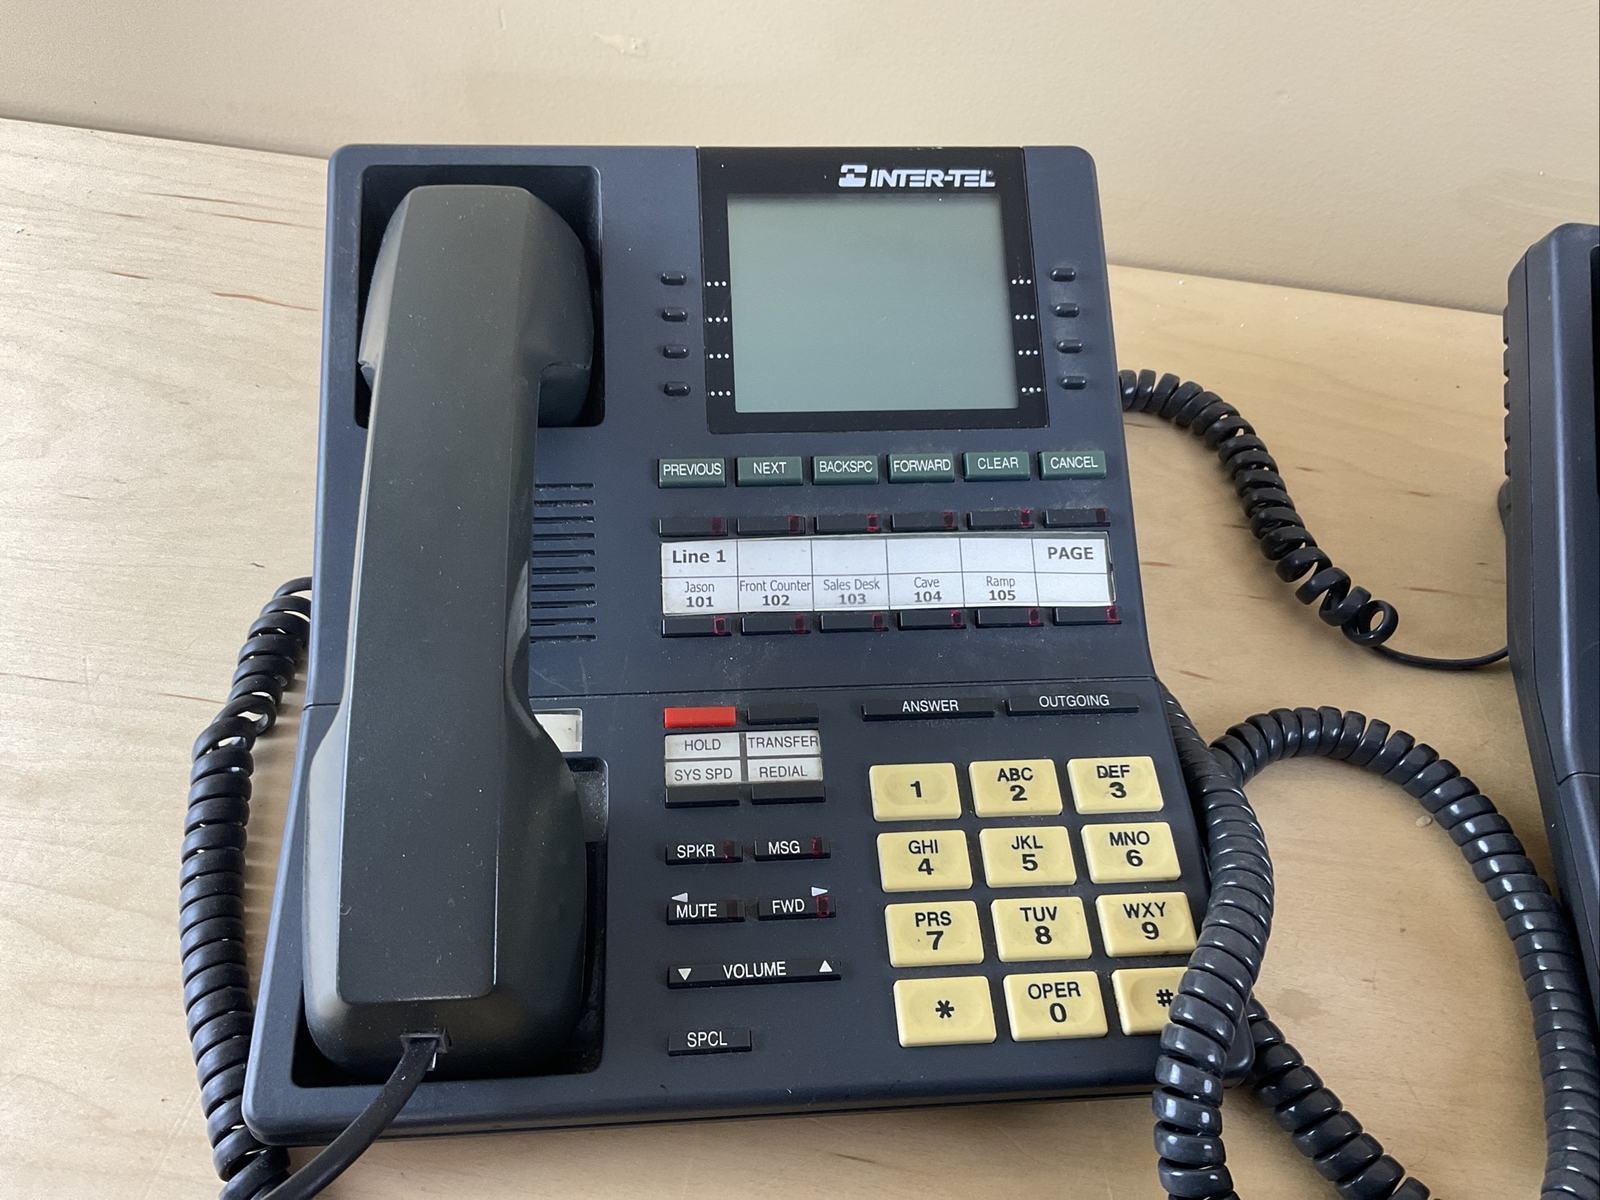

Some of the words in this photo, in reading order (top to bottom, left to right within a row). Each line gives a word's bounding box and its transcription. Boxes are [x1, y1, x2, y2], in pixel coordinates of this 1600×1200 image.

[663, 462, 722, 476] PREVIOUS
[753, 461, 787, 474] NEXT
[819, 460, 873, 473] BACKSPC
[893, 458, 951, 473] FORWARD
[977, 456, 1019, 470] CLEAR
[1050, 456, 1099, 470] CANCEL
[672, 549, 710, 564] Line
[716, 549, 727, 563] 1
[1047, 546, 1094, 560] PAGE
[684, 581, 715, 594] Jason
[739, 580, 768, 593] Front
[770, 579, 812, 592] Counter
[823, 577, 851, 591] Sales
[853, 577, 881, 591] Desk
[913, 576, 940, 589] Cave
[986, 575, 1016, 589] Ramp
[686, 596, 714, 608] 101
[762, 594, 790, 606] 102
[839, 593, 866, 605] 103
[914, 590, 942, 603] 104
[988, 589, 1016, 601] 105
[902, 699, 959, 713] ANSWER
[1039, 694, 1110, 708] OUTGOING
[684, 738, 722, 751] HOLD
[747, 735, 819, 749] TRANSFER
[674, 768, 702, 782] SYS
[705, 767, 733, 780] SPD
[759, 765, 808, 778] REDIAL
[997, 767, 1034, 782] ABC
[1096, 764, 1130, 779] DEF
[910, 780, 922, 798] 1
[1011, 785, 1028, 802] 2
[1109, 781, 1127, 799] 3
[1011, 835, 1044, 850] JKL
[1109, 830, 1150, 847] MNO
[676, 843, 716, 859] SPKR
[768, 840, 801, 855] MSG
[908, 839, 939, 855] GHI
[1021, 853, 1039, 872] 5
[1125, 849, 1144, 867] 6
[917, 857, 935, 876] 4
[676, 903, 718, 919] MUTE
[772, 898, 805, 914] FWD
[1019, 905, 1058, 922] TUV
[1122, 901, 1166, 919] WXY
[914, 910, 952, 928] PRS
[1034, 925, 1053, 945] 8
[1141, 921, 1160, 940] 9
[925, 930, 944, 951] 7
[722, 961, 787, 979] VOLUME
[1027, 981, 1082, 1000] OPER
[1049, 1002, 1067, 1023] 0
[687, 1030, 728, 1048] SPCL
